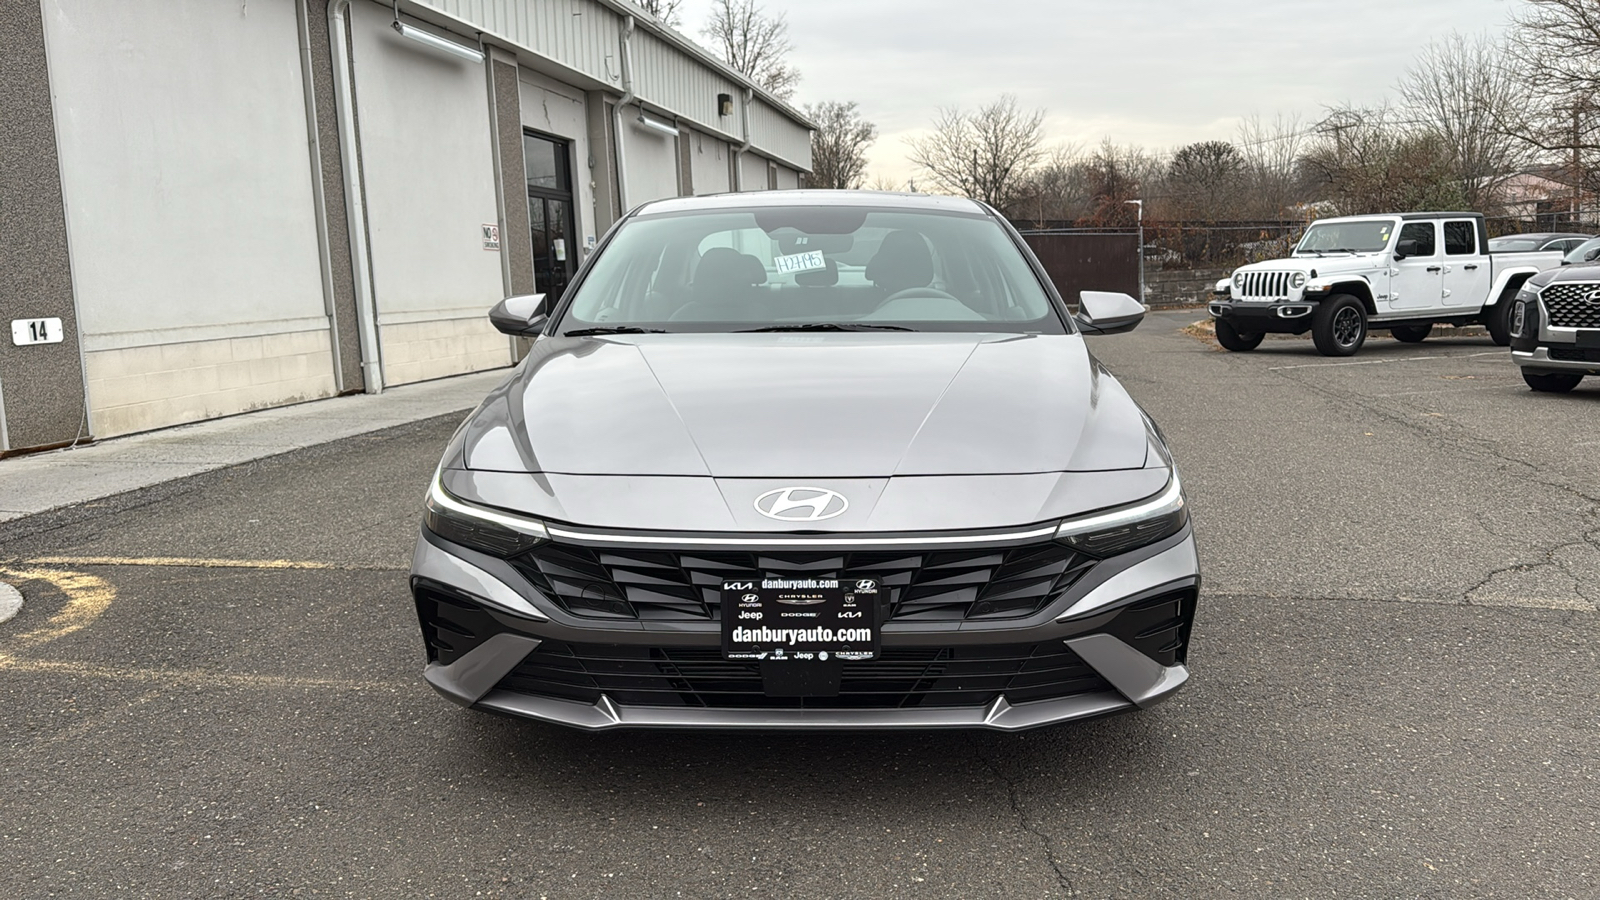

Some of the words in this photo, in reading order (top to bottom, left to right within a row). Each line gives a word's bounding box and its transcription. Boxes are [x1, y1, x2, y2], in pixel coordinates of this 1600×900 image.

[483, 227, 492, 239] NO
[30, 321, 47, 341] 14
[761, 578, 839, 590] danburyauto.com
[738, 610, 763, 620] Jeep
[732, 626, 871, 645] danburyauto.com
[793, 651, 814, 660] Jeep
